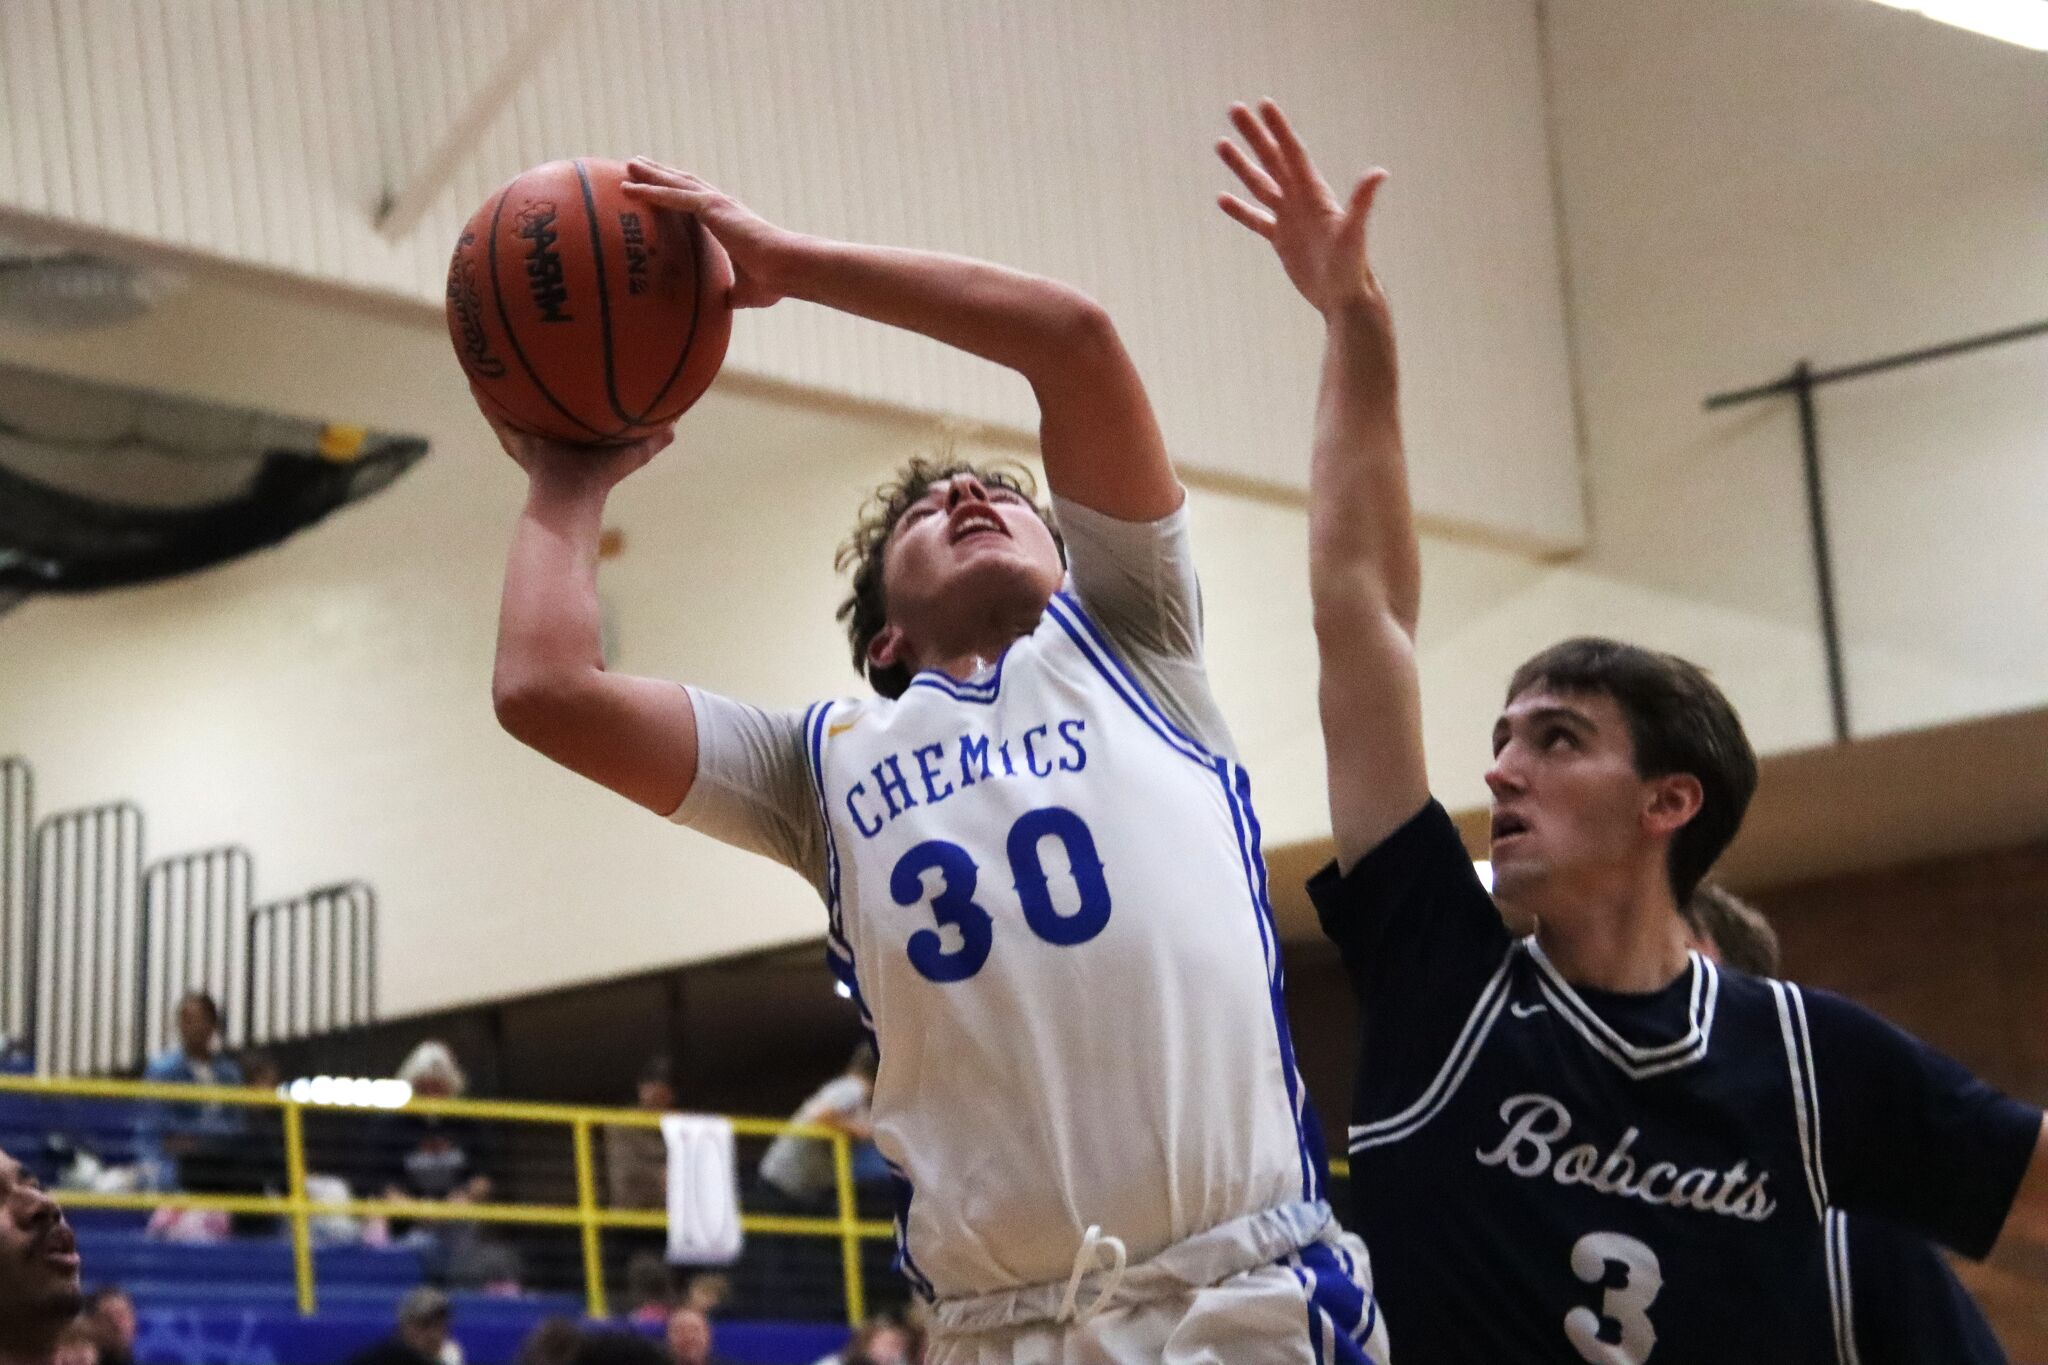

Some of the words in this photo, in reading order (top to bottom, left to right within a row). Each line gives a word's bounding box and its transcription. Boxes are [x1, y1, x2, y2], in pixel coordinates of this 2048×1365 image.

[846, 719, 1087, 838] CHEMICS
[890, 806, 1112, 983] 30
[1475, 1093, 1777, 1222] Bobcats
[1563, 1231, 1664, 1365] 3
